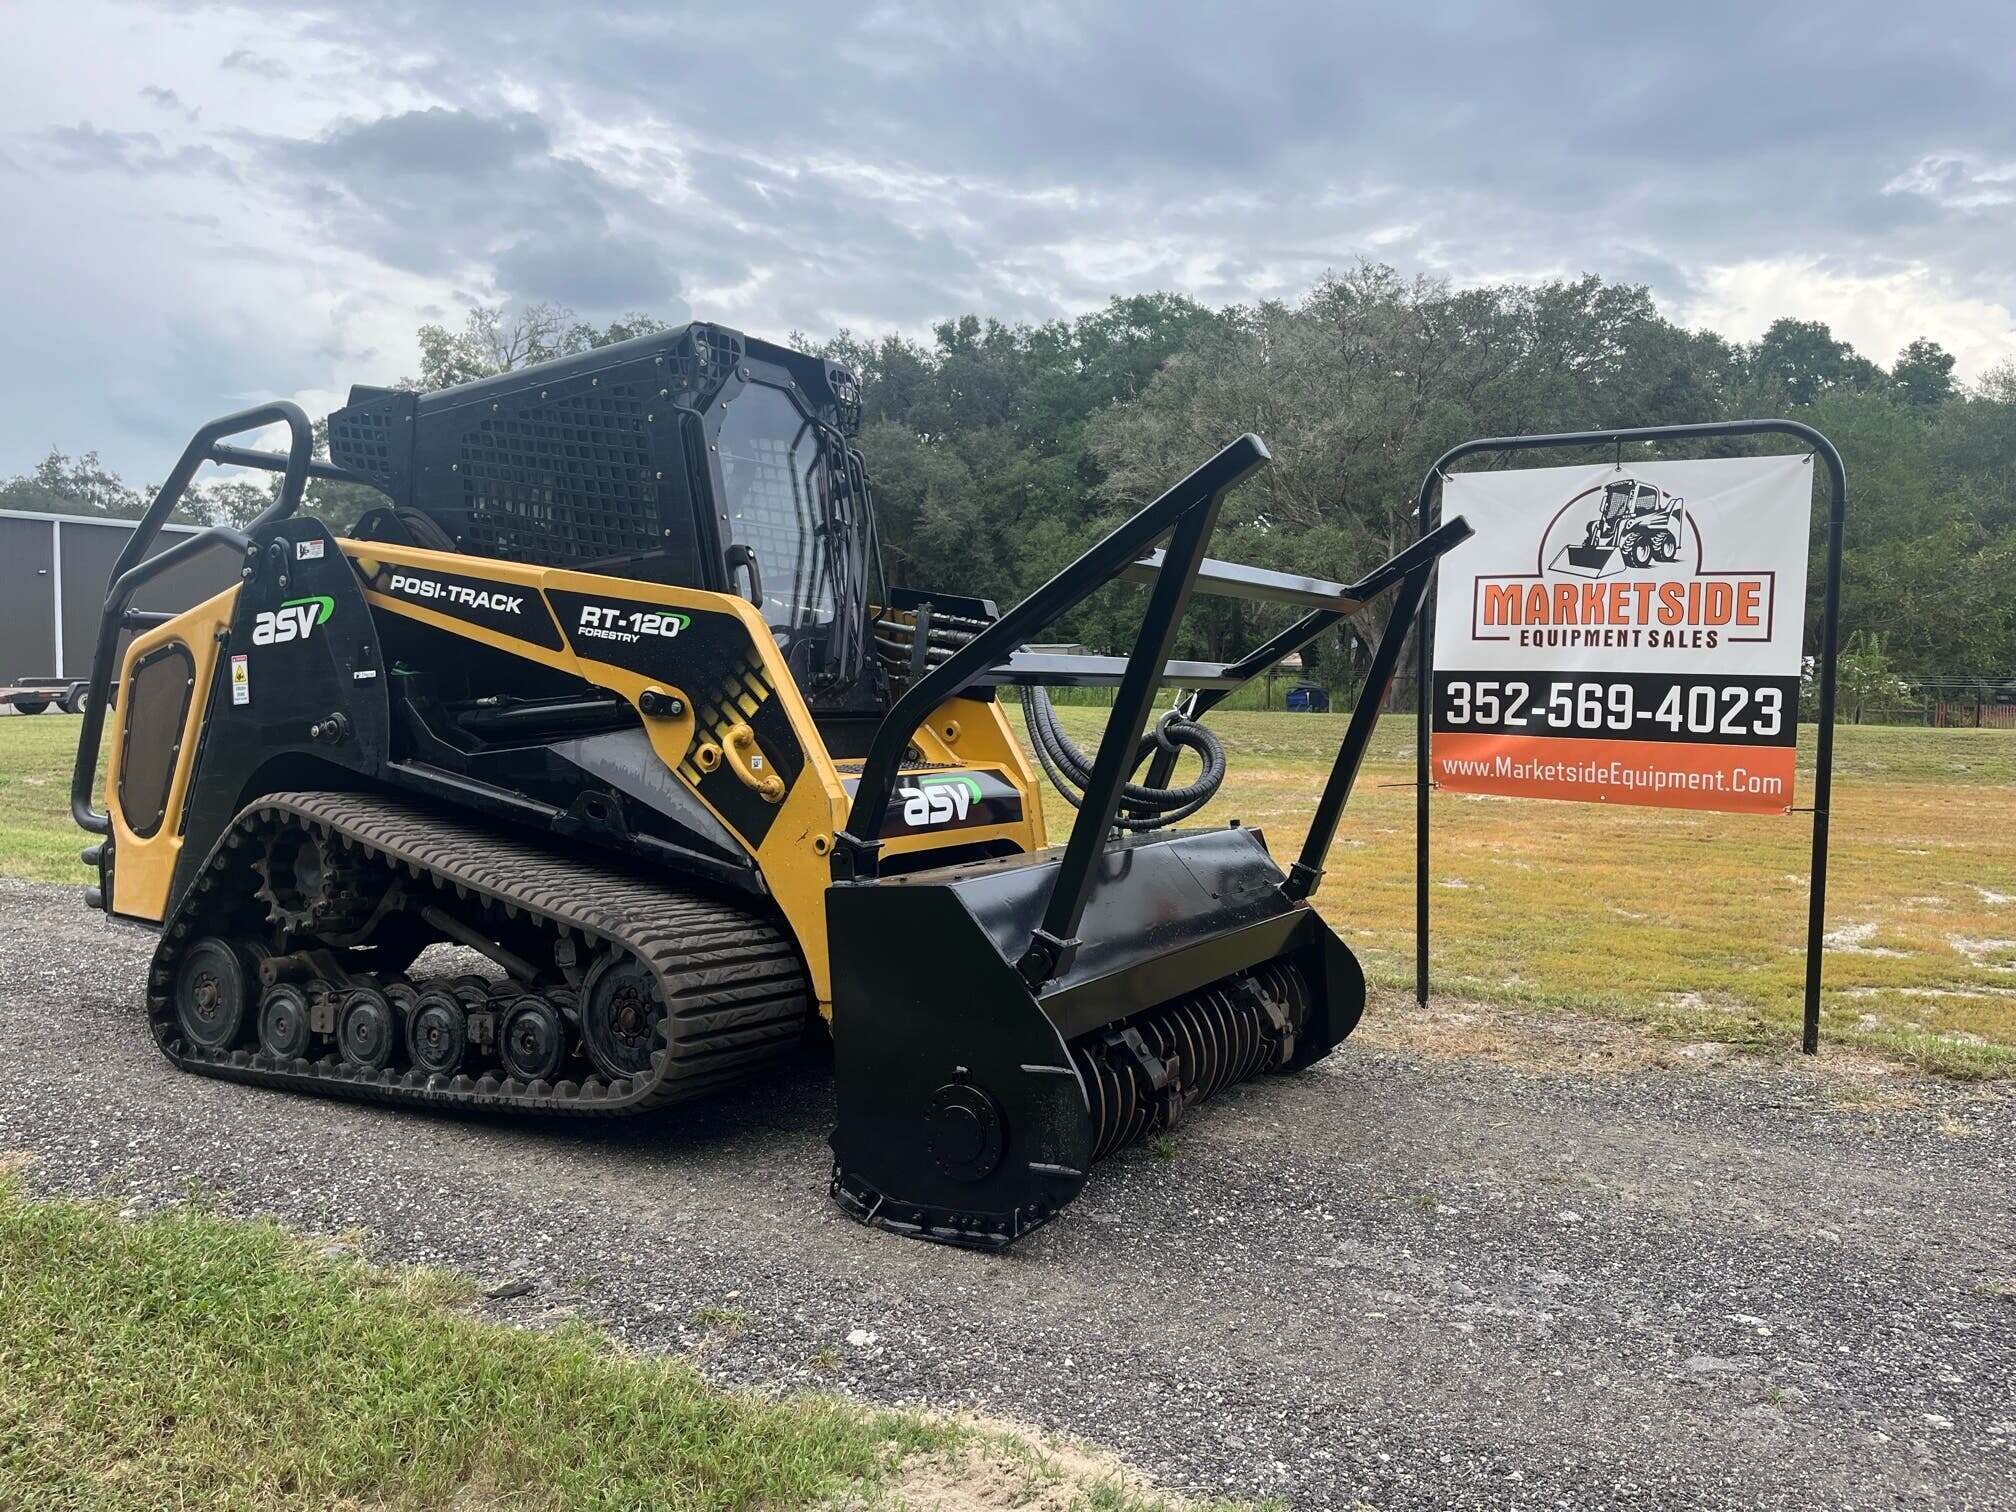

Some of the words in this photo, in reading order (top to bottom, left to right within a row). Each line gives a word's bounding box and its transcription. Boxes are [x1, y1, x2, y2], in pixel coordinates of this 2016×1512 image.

[390, 574, 523, 615] POSI-TRACK
[1483, 581, 1761, 626] MARKETSIDE
[578, 627, 640, 644] FORESTRY
[579, 605, 681, 638] RT-120
[1520, 630, 1641, 648] EQUIPMENT
[1648, 630, 1718, 649] SALES
[1446, 681, 1782, 736] 352-569-4023
[1442, 756, 1782, 795] www.MarketsideEquipment.Com
